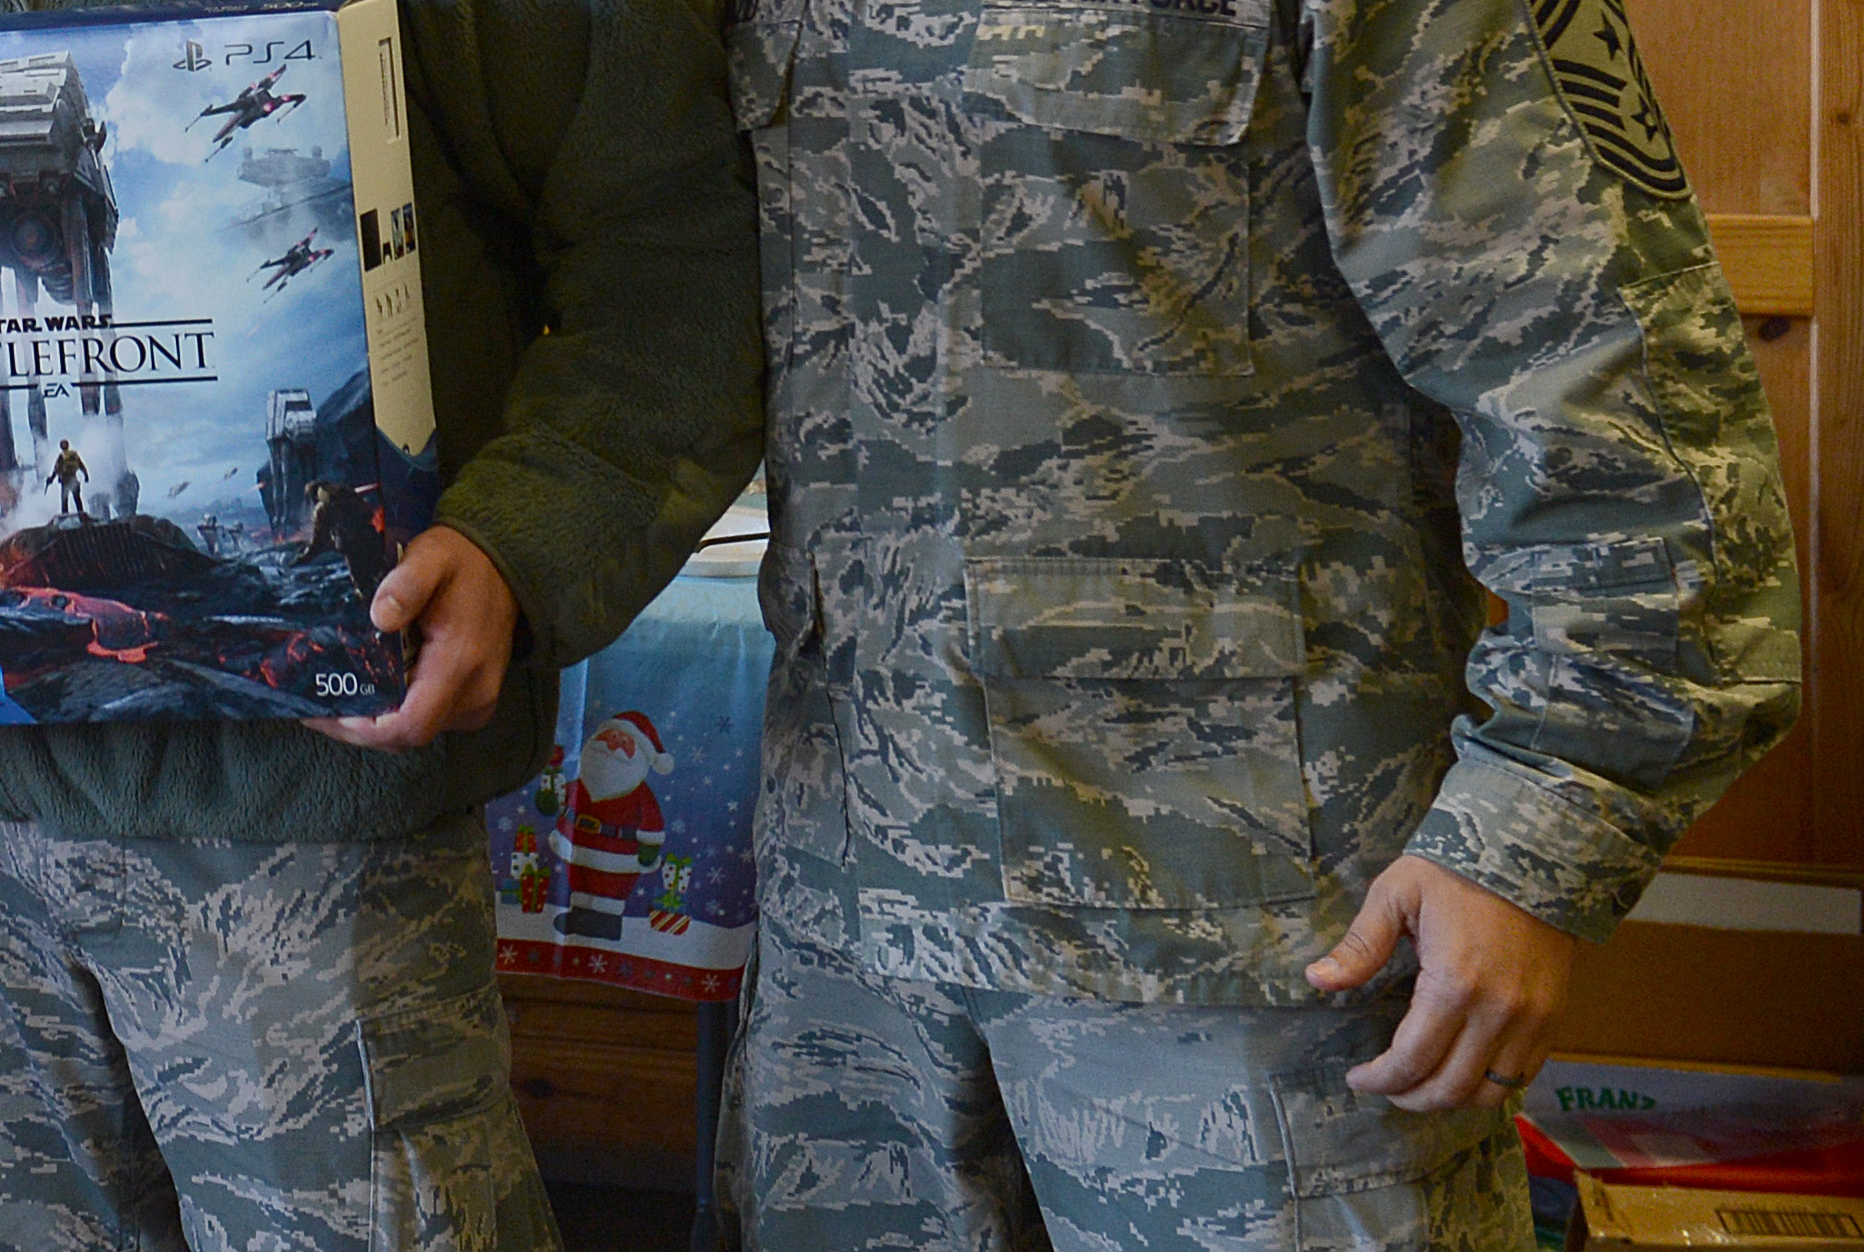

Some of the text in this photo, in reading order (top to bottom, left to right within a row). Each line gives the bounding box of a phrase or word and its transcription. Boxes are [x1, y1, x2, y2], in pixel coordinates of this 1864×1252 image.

[223, 38, 317, 66] PS4
[47, 314, 112, 331] WARS
[43, 382, 71, 399] EA
